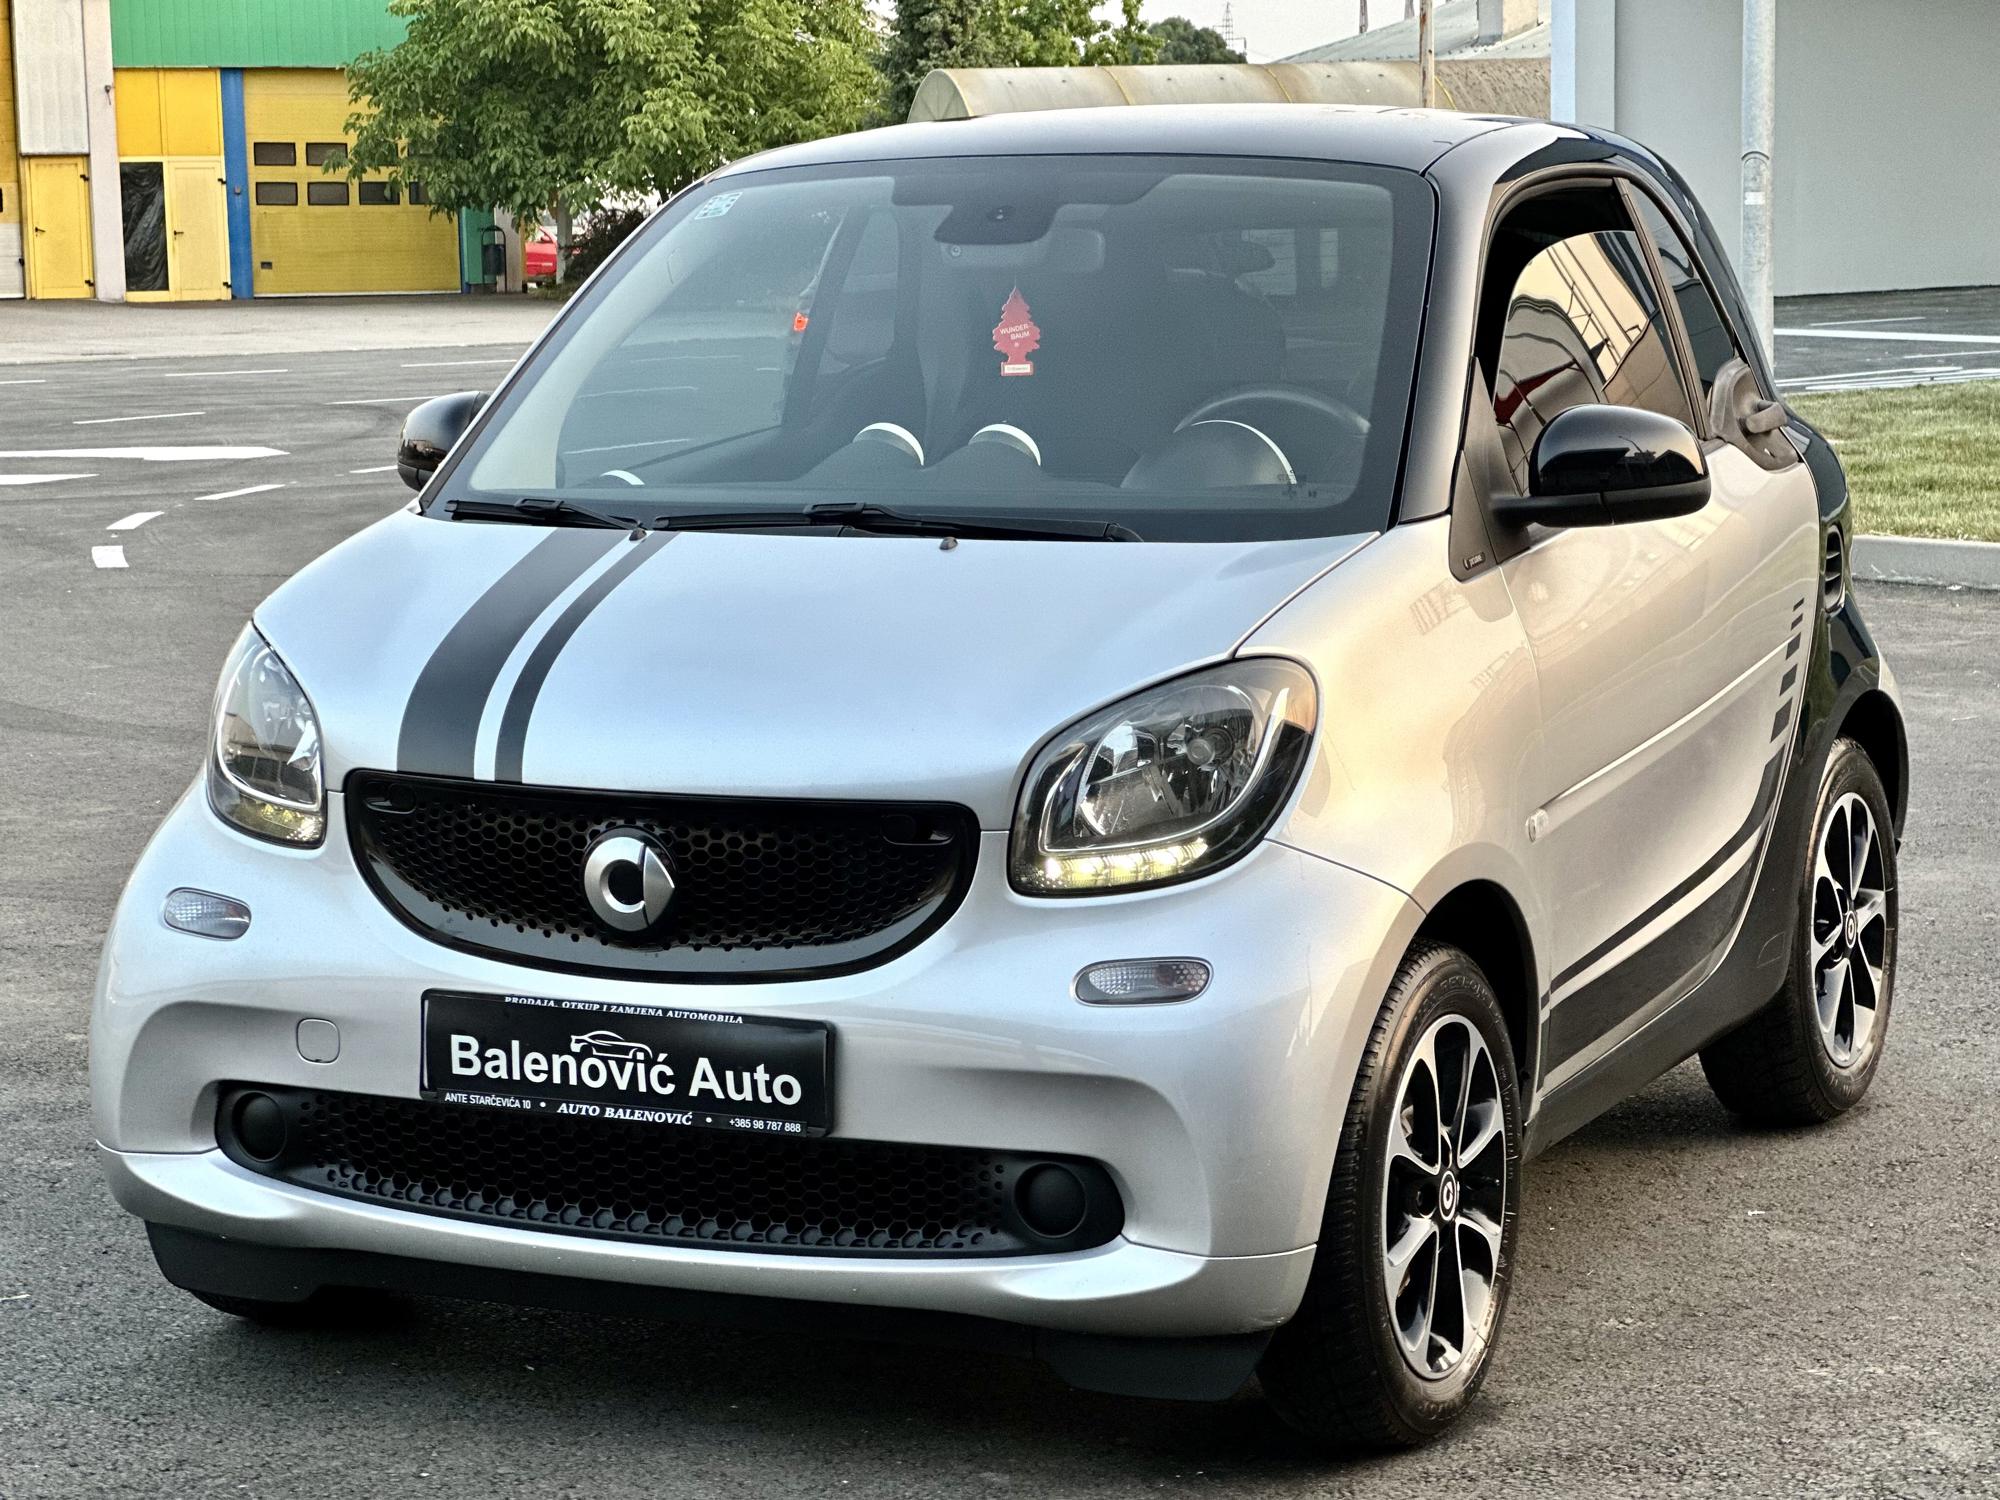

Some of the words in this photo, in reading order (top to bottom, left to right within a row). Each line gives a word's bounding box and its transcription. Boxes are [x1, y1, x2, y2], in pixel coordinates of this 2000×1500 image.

[562, 1001, 600, 1011] OTKUP
[602, 1004, 608, 1012] I
[610, 1005, 663, 1017] ZAMJENA
[666, 1010, 743, 1024] AUTOMOBILA
[450, 1034, 676, 1095] Balenović
[688, 1057, 802, 1106] Auto
[444, 1092, 468, 1103] ANTE
[469, 1094, 521, 1109] STARČEVIĆA
[522, 1100, 531, 1109] 10
[557, 1102, 600, 1116] AUTO
[604, 1107, 693, 1125] BALENOVIĆ
[729, 1118, 751, 1128] +385
[752, 1119, 764, 1130] 98
[766, 1121, 782, 1131] 787
[784, 1122, 801, 1133] 888
